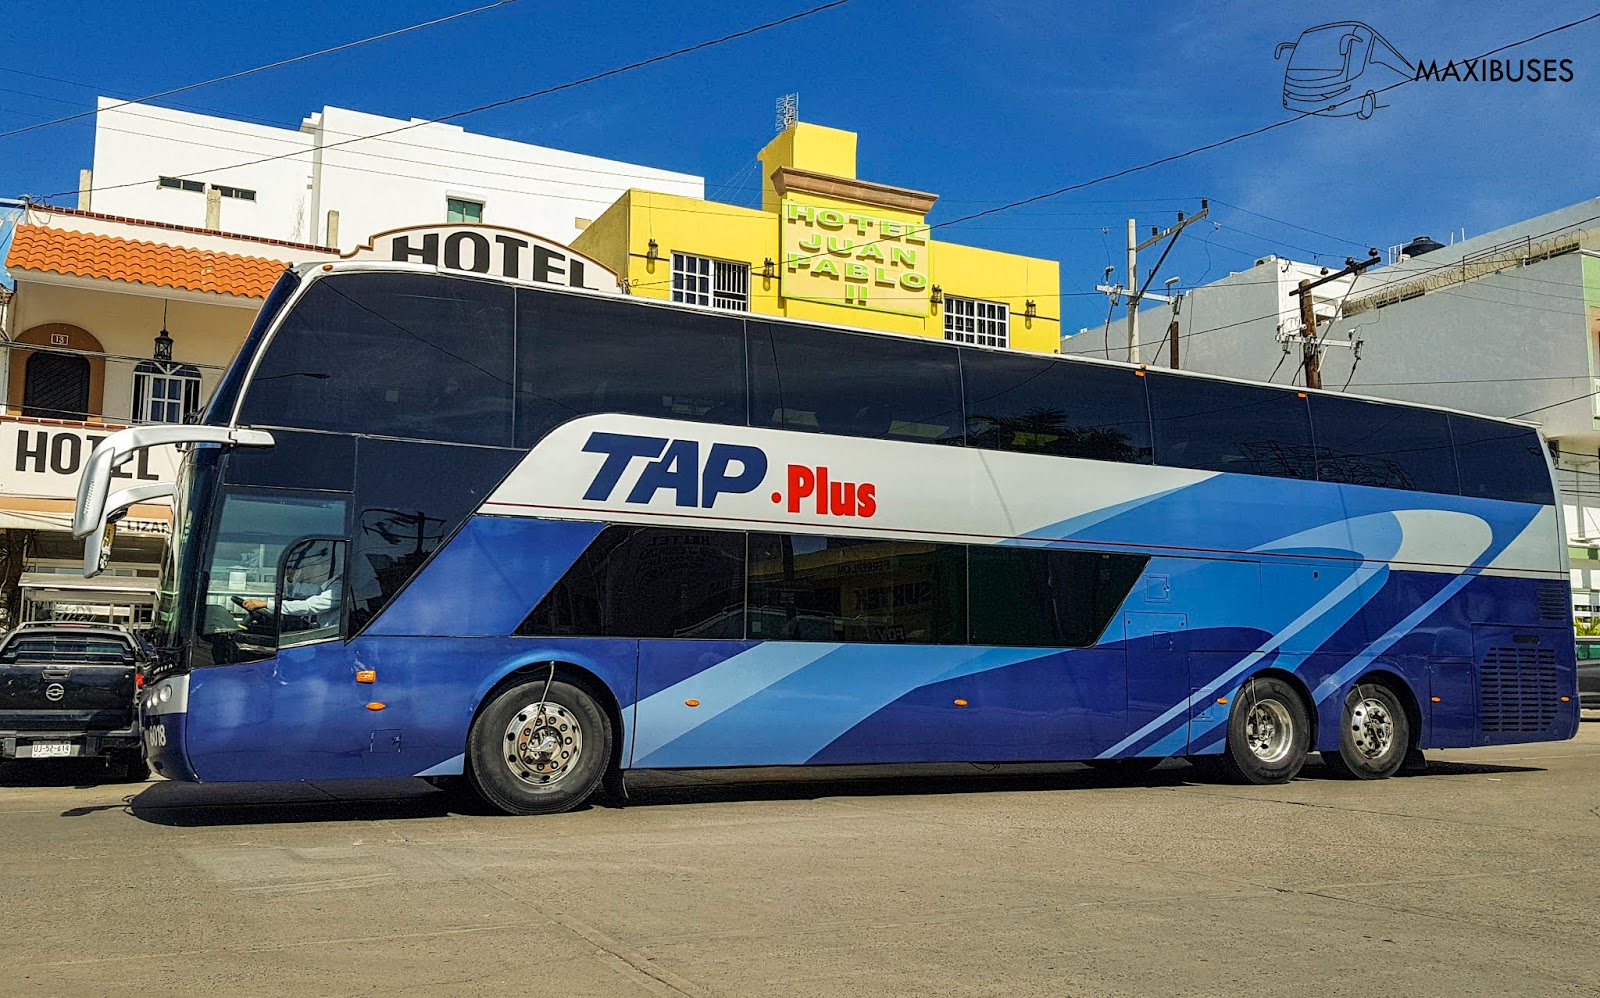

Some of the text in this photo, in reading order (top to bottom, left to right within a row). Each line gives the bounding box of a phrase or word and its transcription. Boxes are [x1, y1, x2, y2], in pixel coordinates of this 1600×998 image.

[787, 203, 927, 246] HOTEL
[391, 230, 600, 291] HOTEL
[798, 233, 917, 269] JUAN
[787, 252, 927, 292] PABLO
[844, 283, 869, 306] II
[580, 431, 768, 509] TAP
